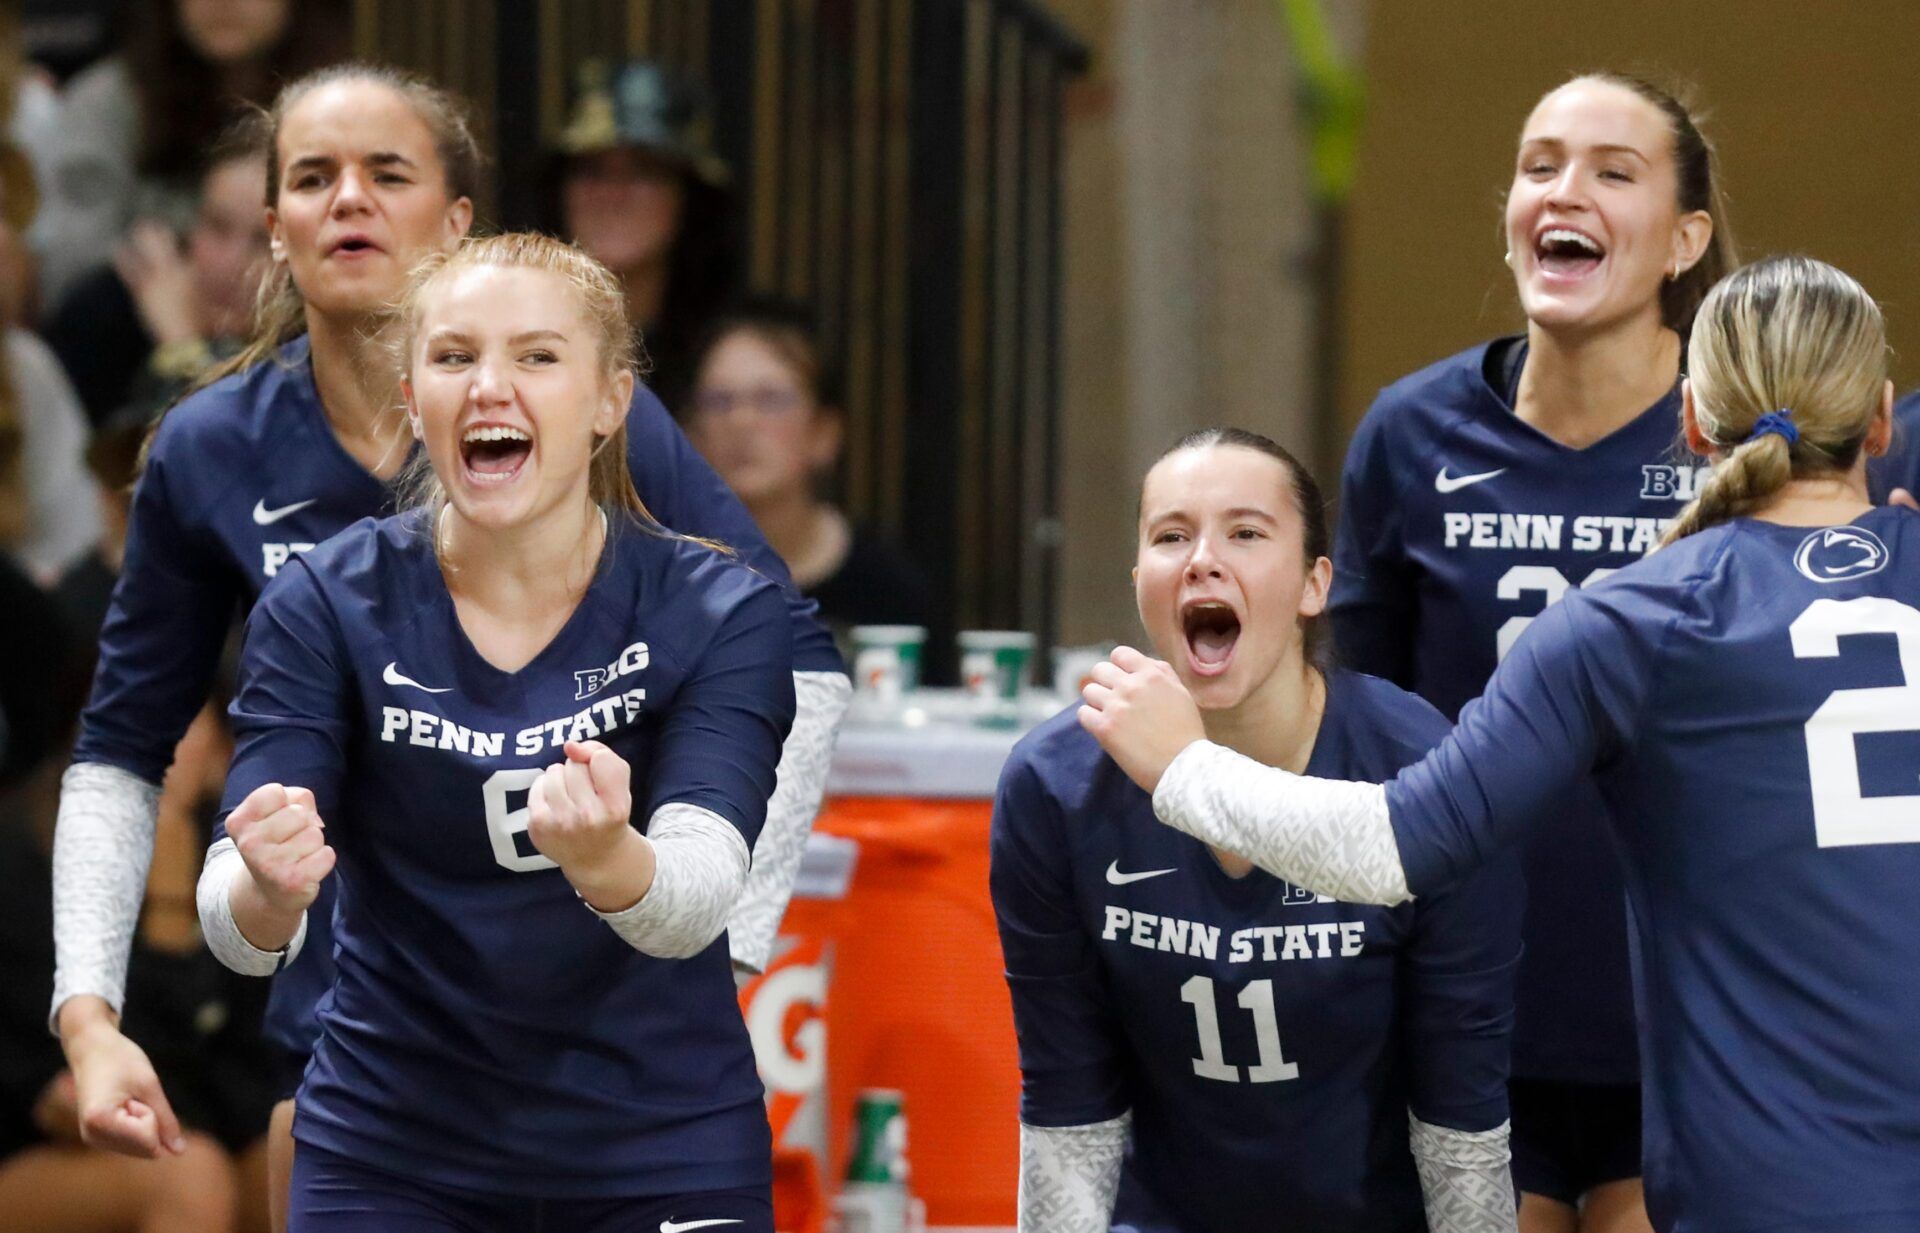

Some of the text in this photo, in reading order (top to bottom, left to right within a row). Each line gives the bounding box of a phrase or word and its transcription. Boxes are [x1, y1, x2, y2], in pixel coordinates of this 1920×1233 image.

[1444, 512, 1564, 549] PENN
[381, 689, 646, 757] PENN STATE
[1789, 596, 1920, 848] 2
[1102, 905, 1365, 963] PENN STATE
[748, 965, 828, 1092] G
[1180, 975, 1299, 1083] 11
